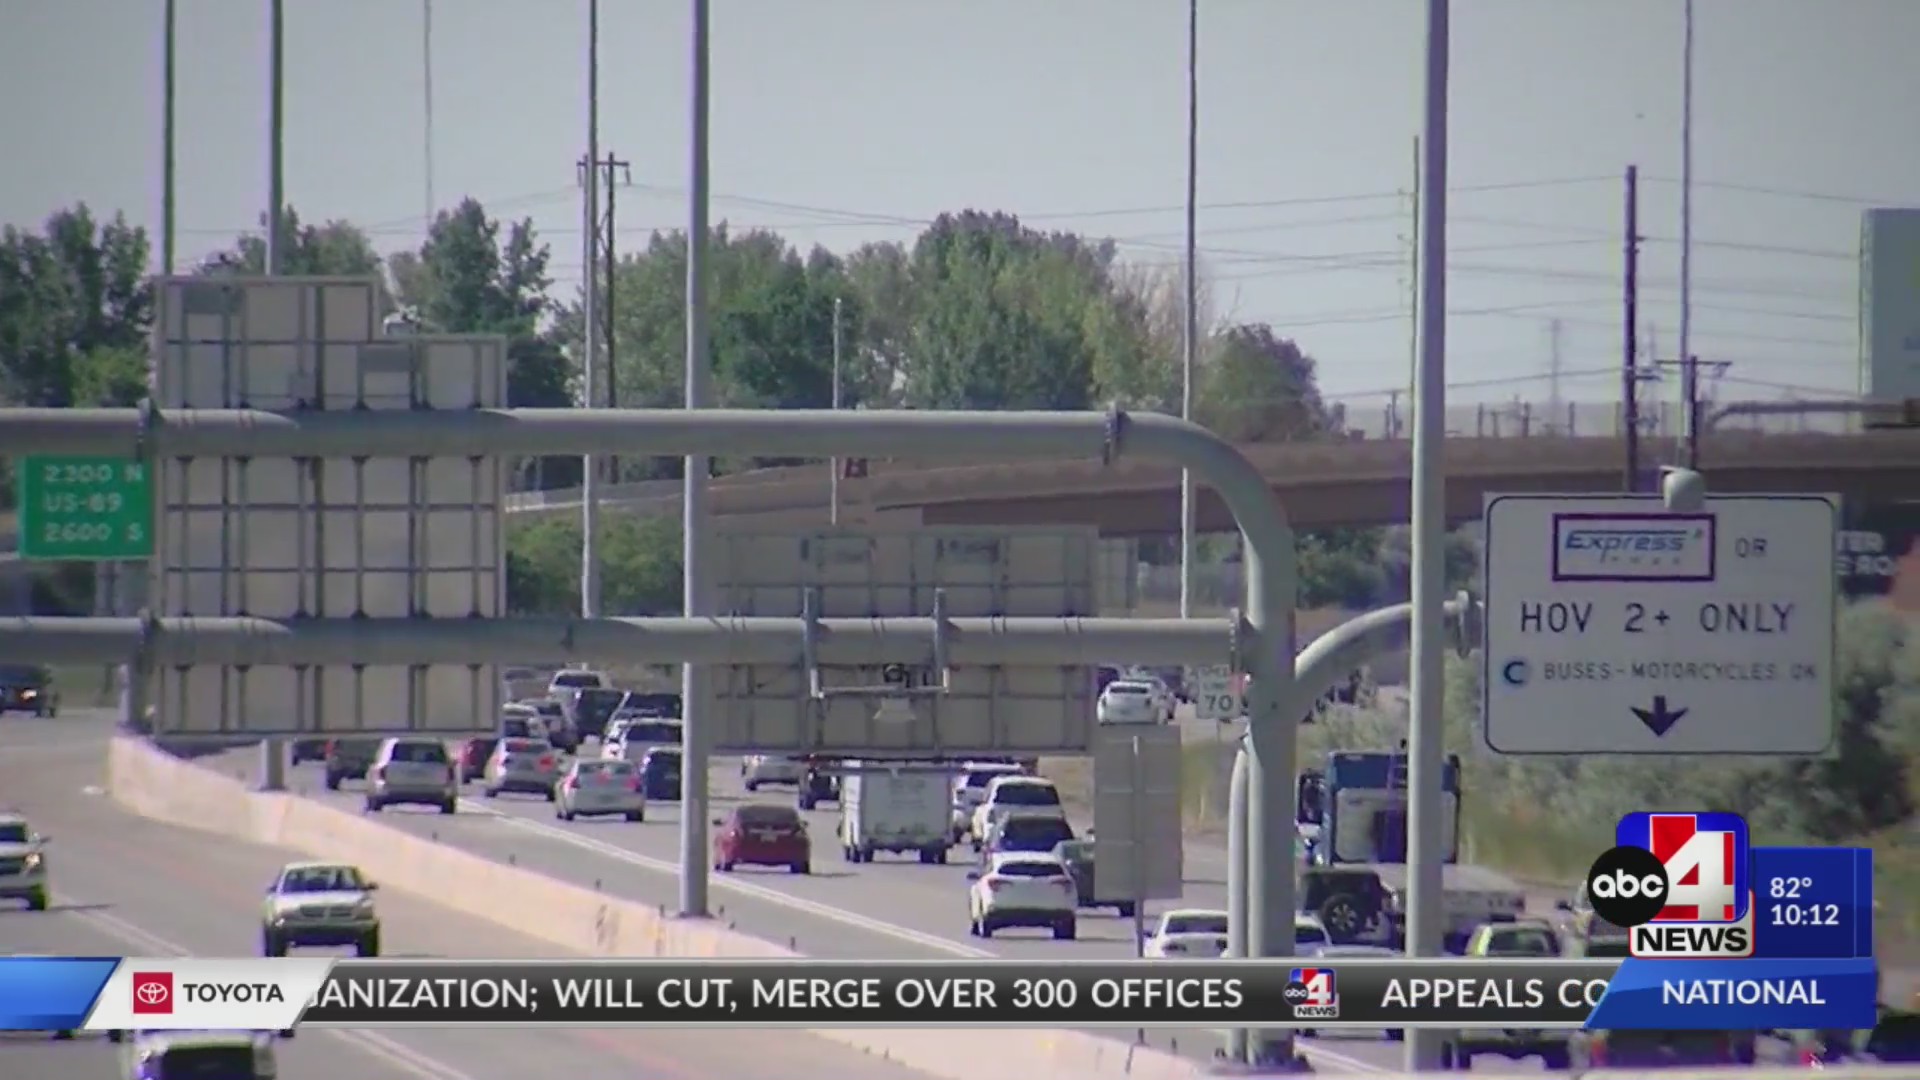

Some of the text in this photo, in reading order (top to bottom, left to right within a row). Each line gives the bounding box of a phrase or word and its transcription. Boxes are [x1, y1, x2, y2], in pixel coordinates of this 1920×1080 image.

[127, 522, 143, 541] S
[1565, 530, 1767, 563] Express OR
[1520, 602, 1795, 633] HOV 2+ ONLY
[1203, 694, 1234, 712] 70
